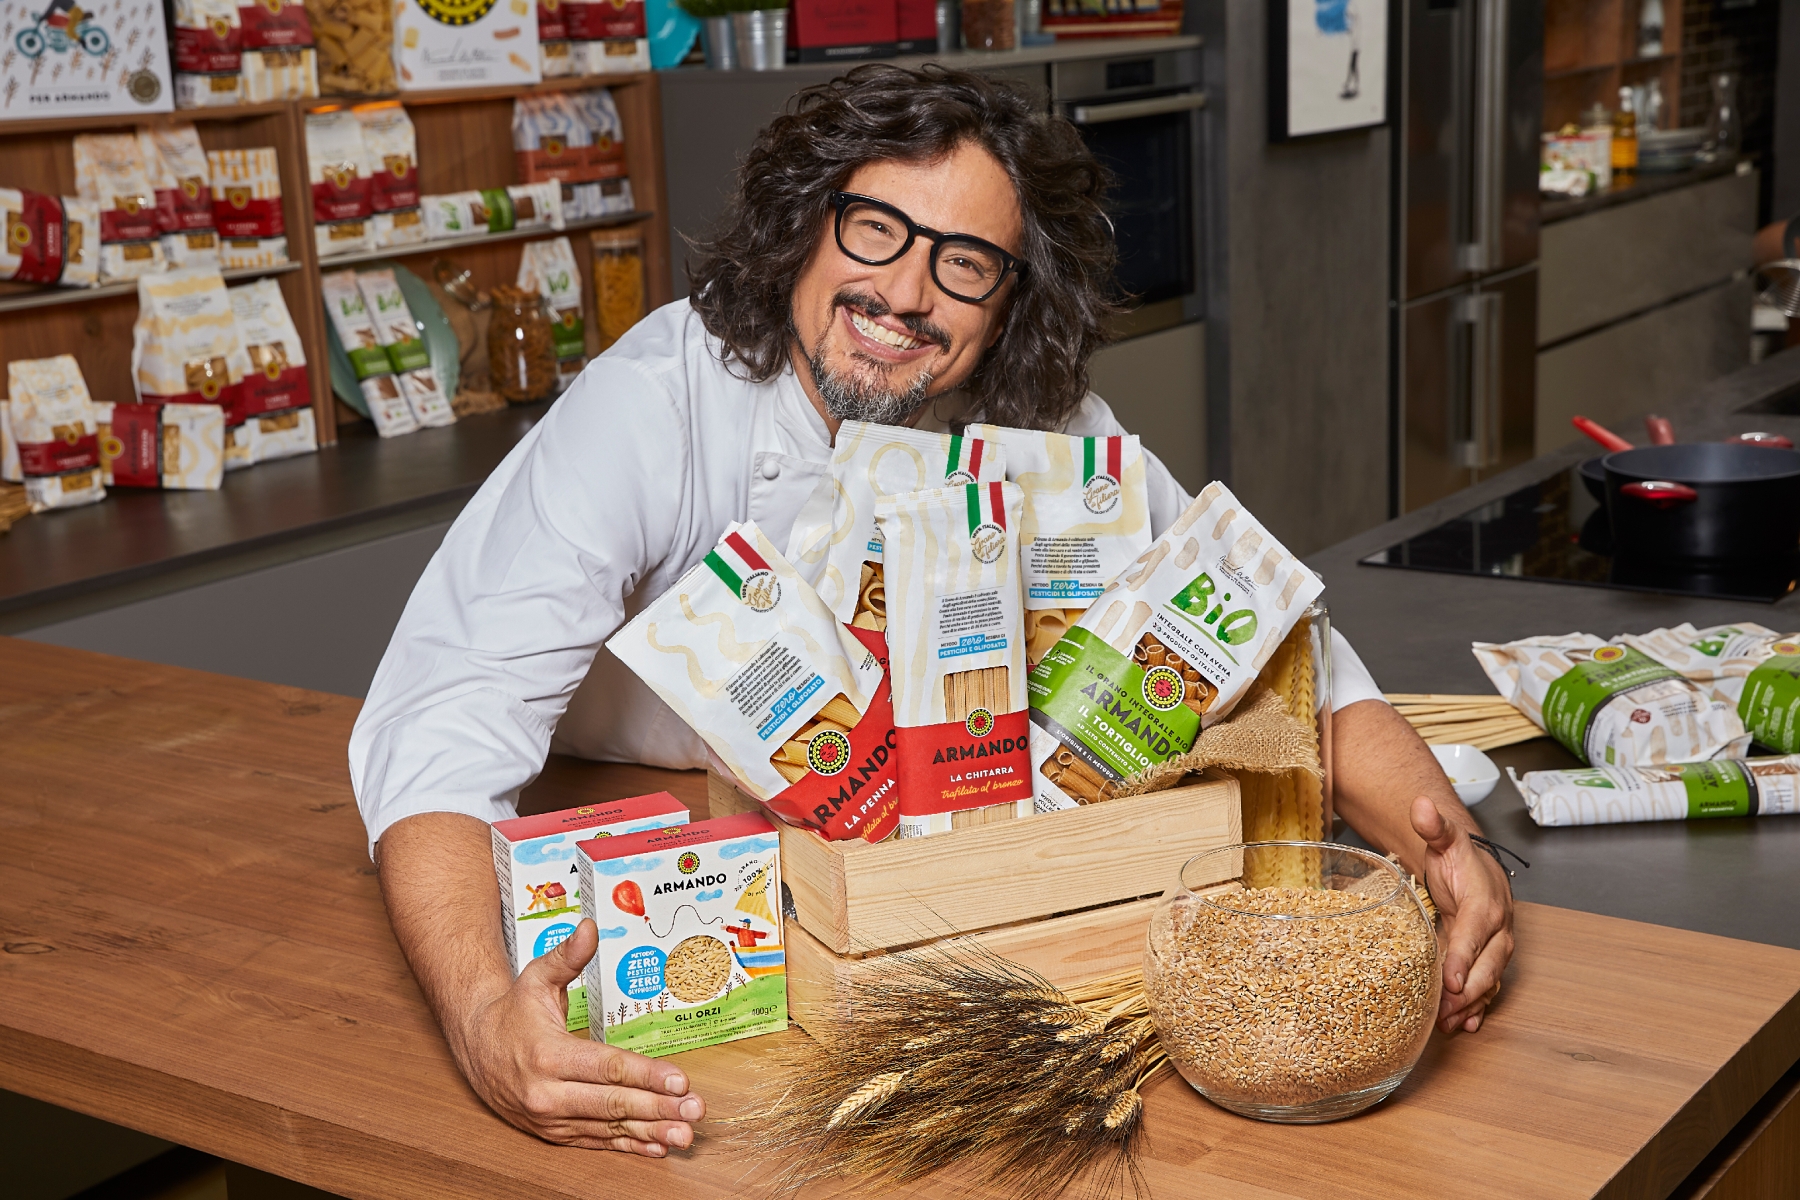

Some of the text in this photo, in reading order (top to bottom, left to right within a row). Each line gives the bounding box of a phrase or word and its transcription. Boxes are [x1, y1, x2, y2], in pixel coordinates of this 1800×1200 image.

[1096, 475, 1116, 486] ITALIANO
[982, 524, 1002, 534] ITALIANO
[746, 572, 768, 584] ITALIANO
[1052, 582, 1078, 590] zero
[940, 647, 968, 656] PESTICIDI
[973, 641, 1006, 650] GLIFOSATO
[960, 637, 985, 646] zero
[1156, 612, 1231, 677] INTEGRALE CON AVENA
[1163, 632, 1190, 655] PRODUCT
[1198, 659, 1214, 674] ITALY
[756, 713, 772, 730] METODO
[774, 690, 796, 713] zero
[796, 678, 810, 691] RESIDUI
[761, 712, 787, 738] PESTICIDI
[792, 679, 822, 708] GLIFOSATO
[1078, 705, 1088, 718] IL
[1086, 665, 1188, 749] IL GRANO INTEGRALE BIO
[932, 736, 1028, 765] ARMANDO
[1076, 722, 1084, 731] AD
[1085, 725, 1098, 742] ALTO
[1099, 739, 1128, 766] CONTENUTO
[1056, 729, 1082, 753] L'ORIGINE
[1092, 758, 1114, 779] METODO
[950, 766, 1014, 782] LA CHITARRA
[941, 779, 1024, 800] trafilata al bronzo
[844, 778, 895, 830] LA PENNA
[562, 809, 622, 823] ARMANDO
[647, 830, 710, 843] ARMANDO
[743, 868, 763, 883] 100%
[654, 874, 727, 895] ARMANDO
[547, 927, 570, 936] METODO
[545, 934, 571, 947] ZER
[628, 957, 659, 970] ZERO
[627, 967, 660, 976] PESTICIDI
[629, 975, 660, 989] ZERO
[675, 1007, 720, 1022] GLI ORZI
